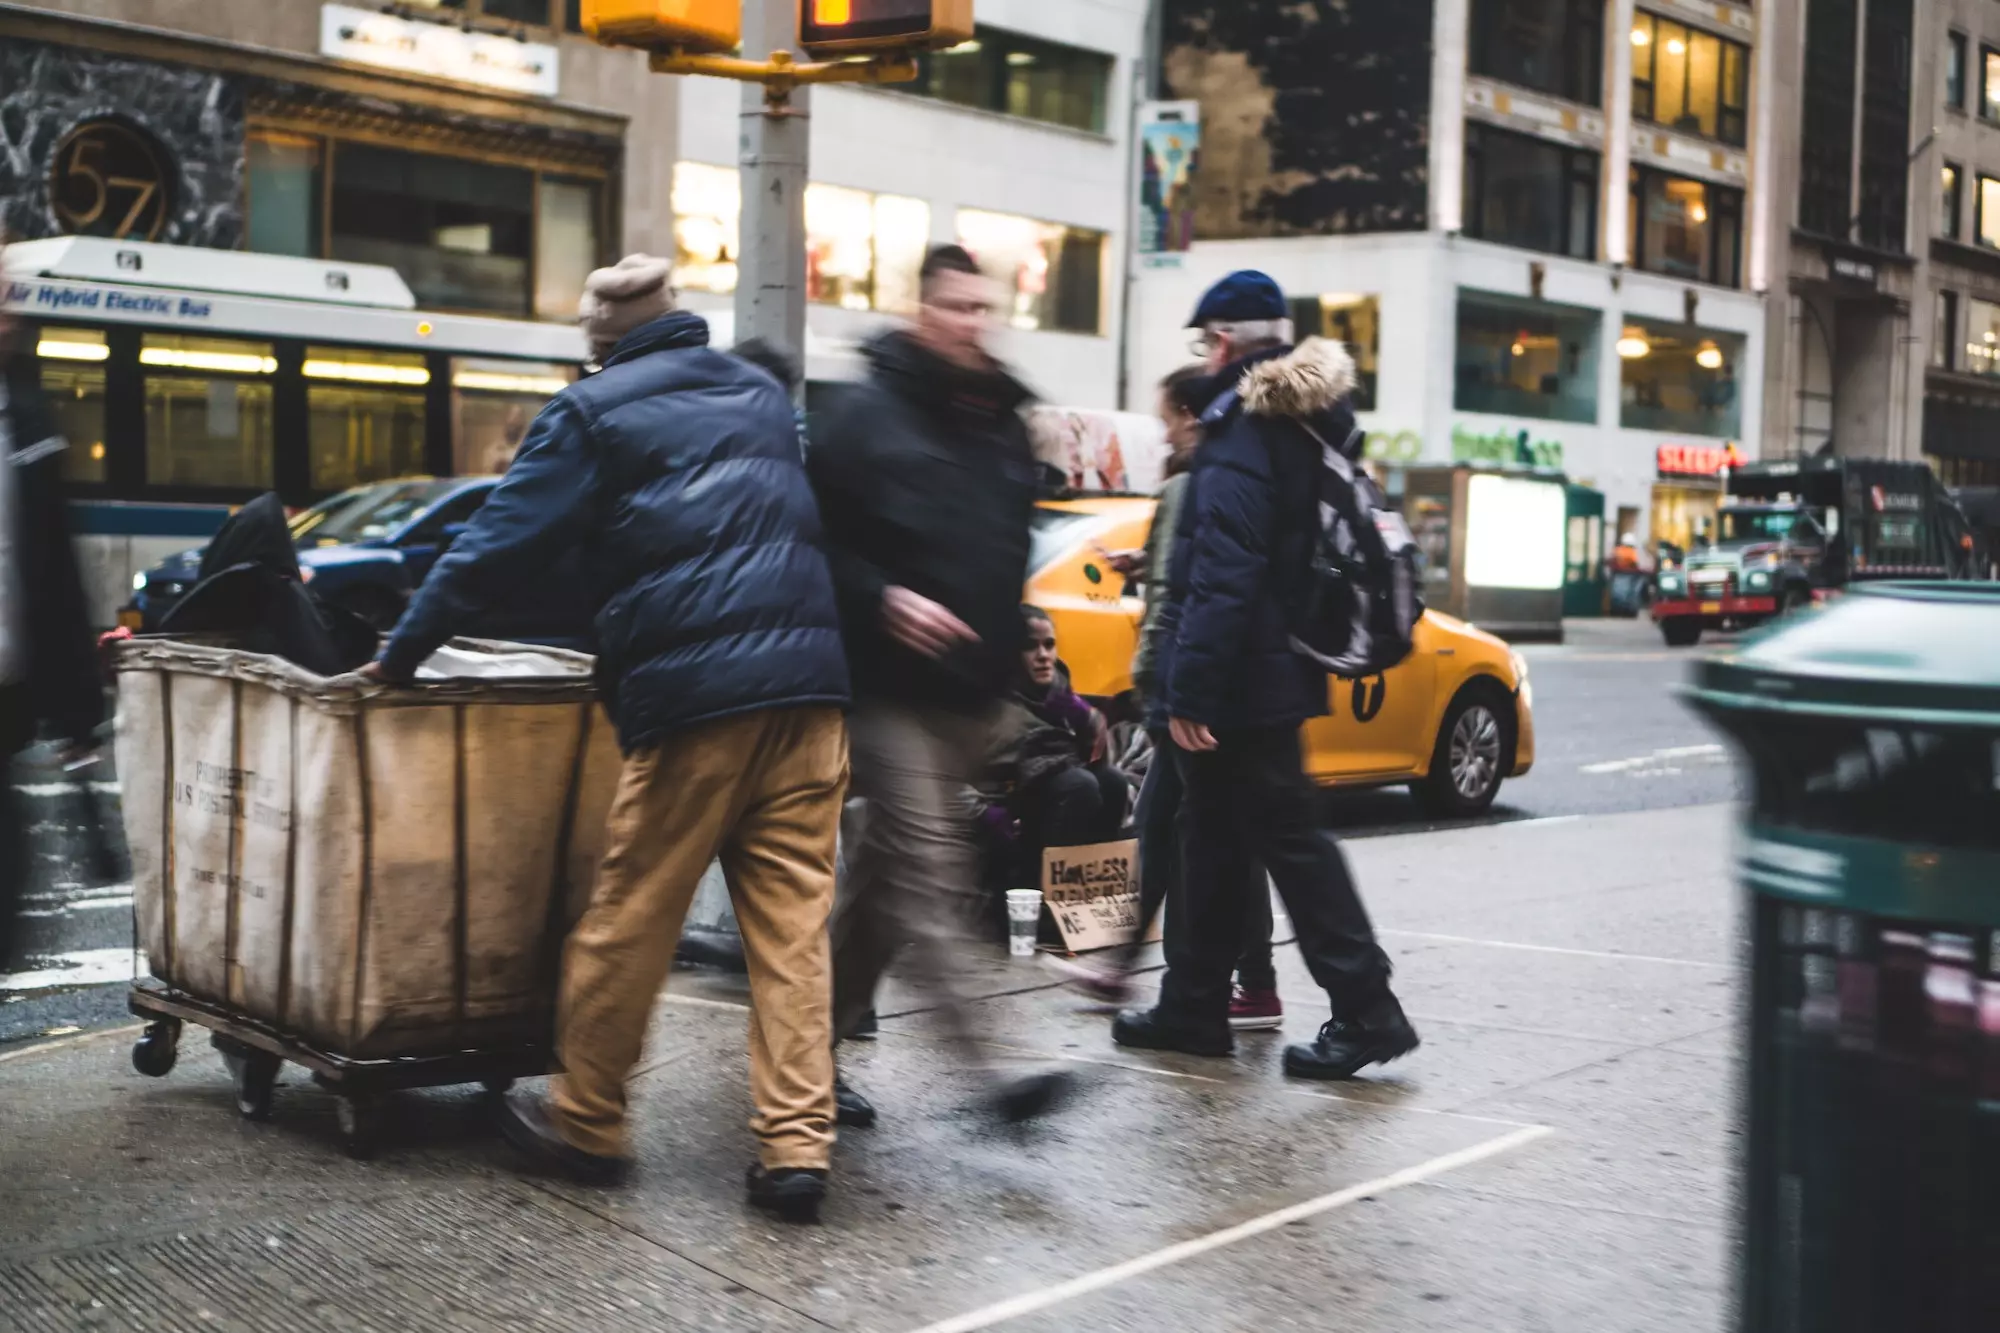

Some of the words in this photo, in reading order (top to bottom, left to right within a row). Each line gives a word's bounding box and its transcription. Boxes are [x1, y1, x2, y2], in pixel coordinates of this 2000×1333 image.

[58, 139, 156, 241] 57
[38, 286, 100, 310] Hybrid
[106, 290, 172, 316] Electric
[178, 297, 212, 318] Bus
[1360, 675, 1379, 715] T
[1060, 911, 1087, 935] ME
